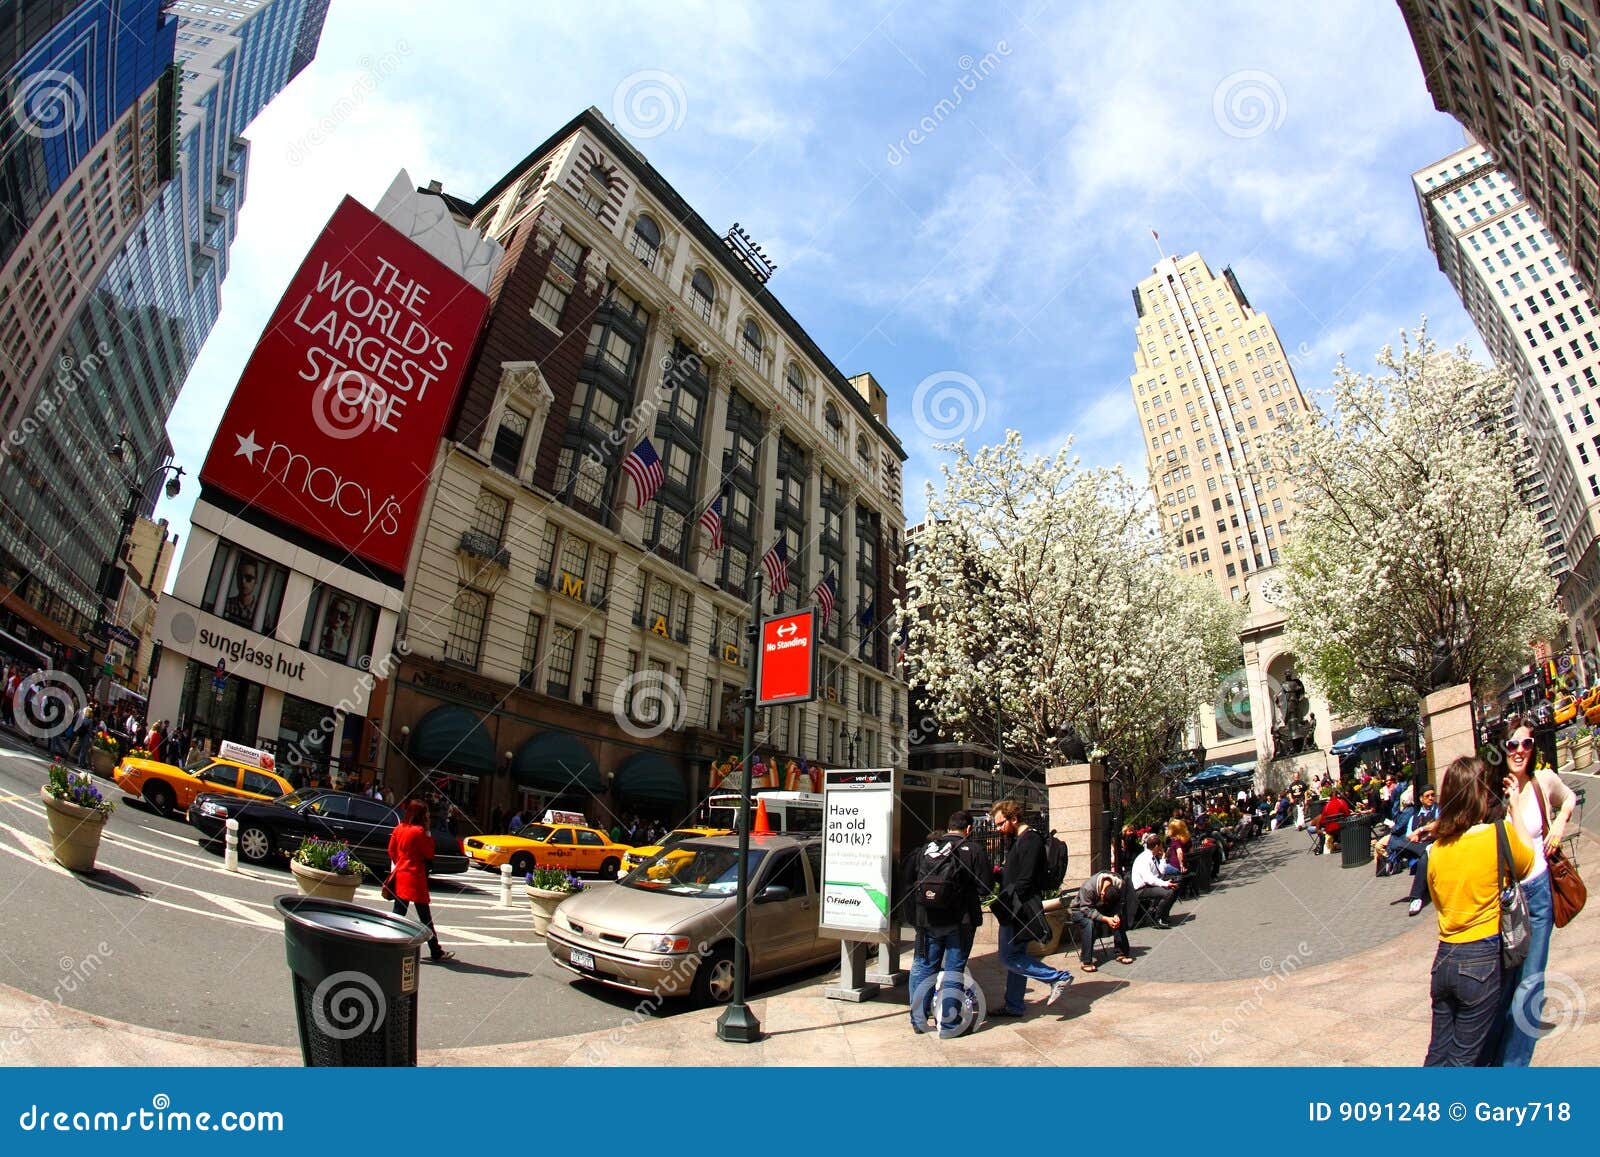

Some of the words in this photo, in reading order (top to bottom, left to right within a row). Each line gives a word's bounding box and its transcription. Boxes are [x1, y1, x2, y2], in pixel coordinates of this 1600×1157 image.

[372, 256, 430, 317] THE
[316, 261, 453, 371] WORLD'S
[293, 294, 439, 402] LARGEST
[298, 346, 407, 434] STORE
[199, 628, 273, 669] sunglass
[276, 652, 306, 681] hut
[766, 643, 776, 652] No
[777, 637, 808, 650] Standing
[828, 821, 842, 830] an
[846, 818, 866, 830] old
[830, 804, 859, 816] Have
[828, 832, 873, 846] 401(k)?
[833, 897, 862, 907] Fidelity
